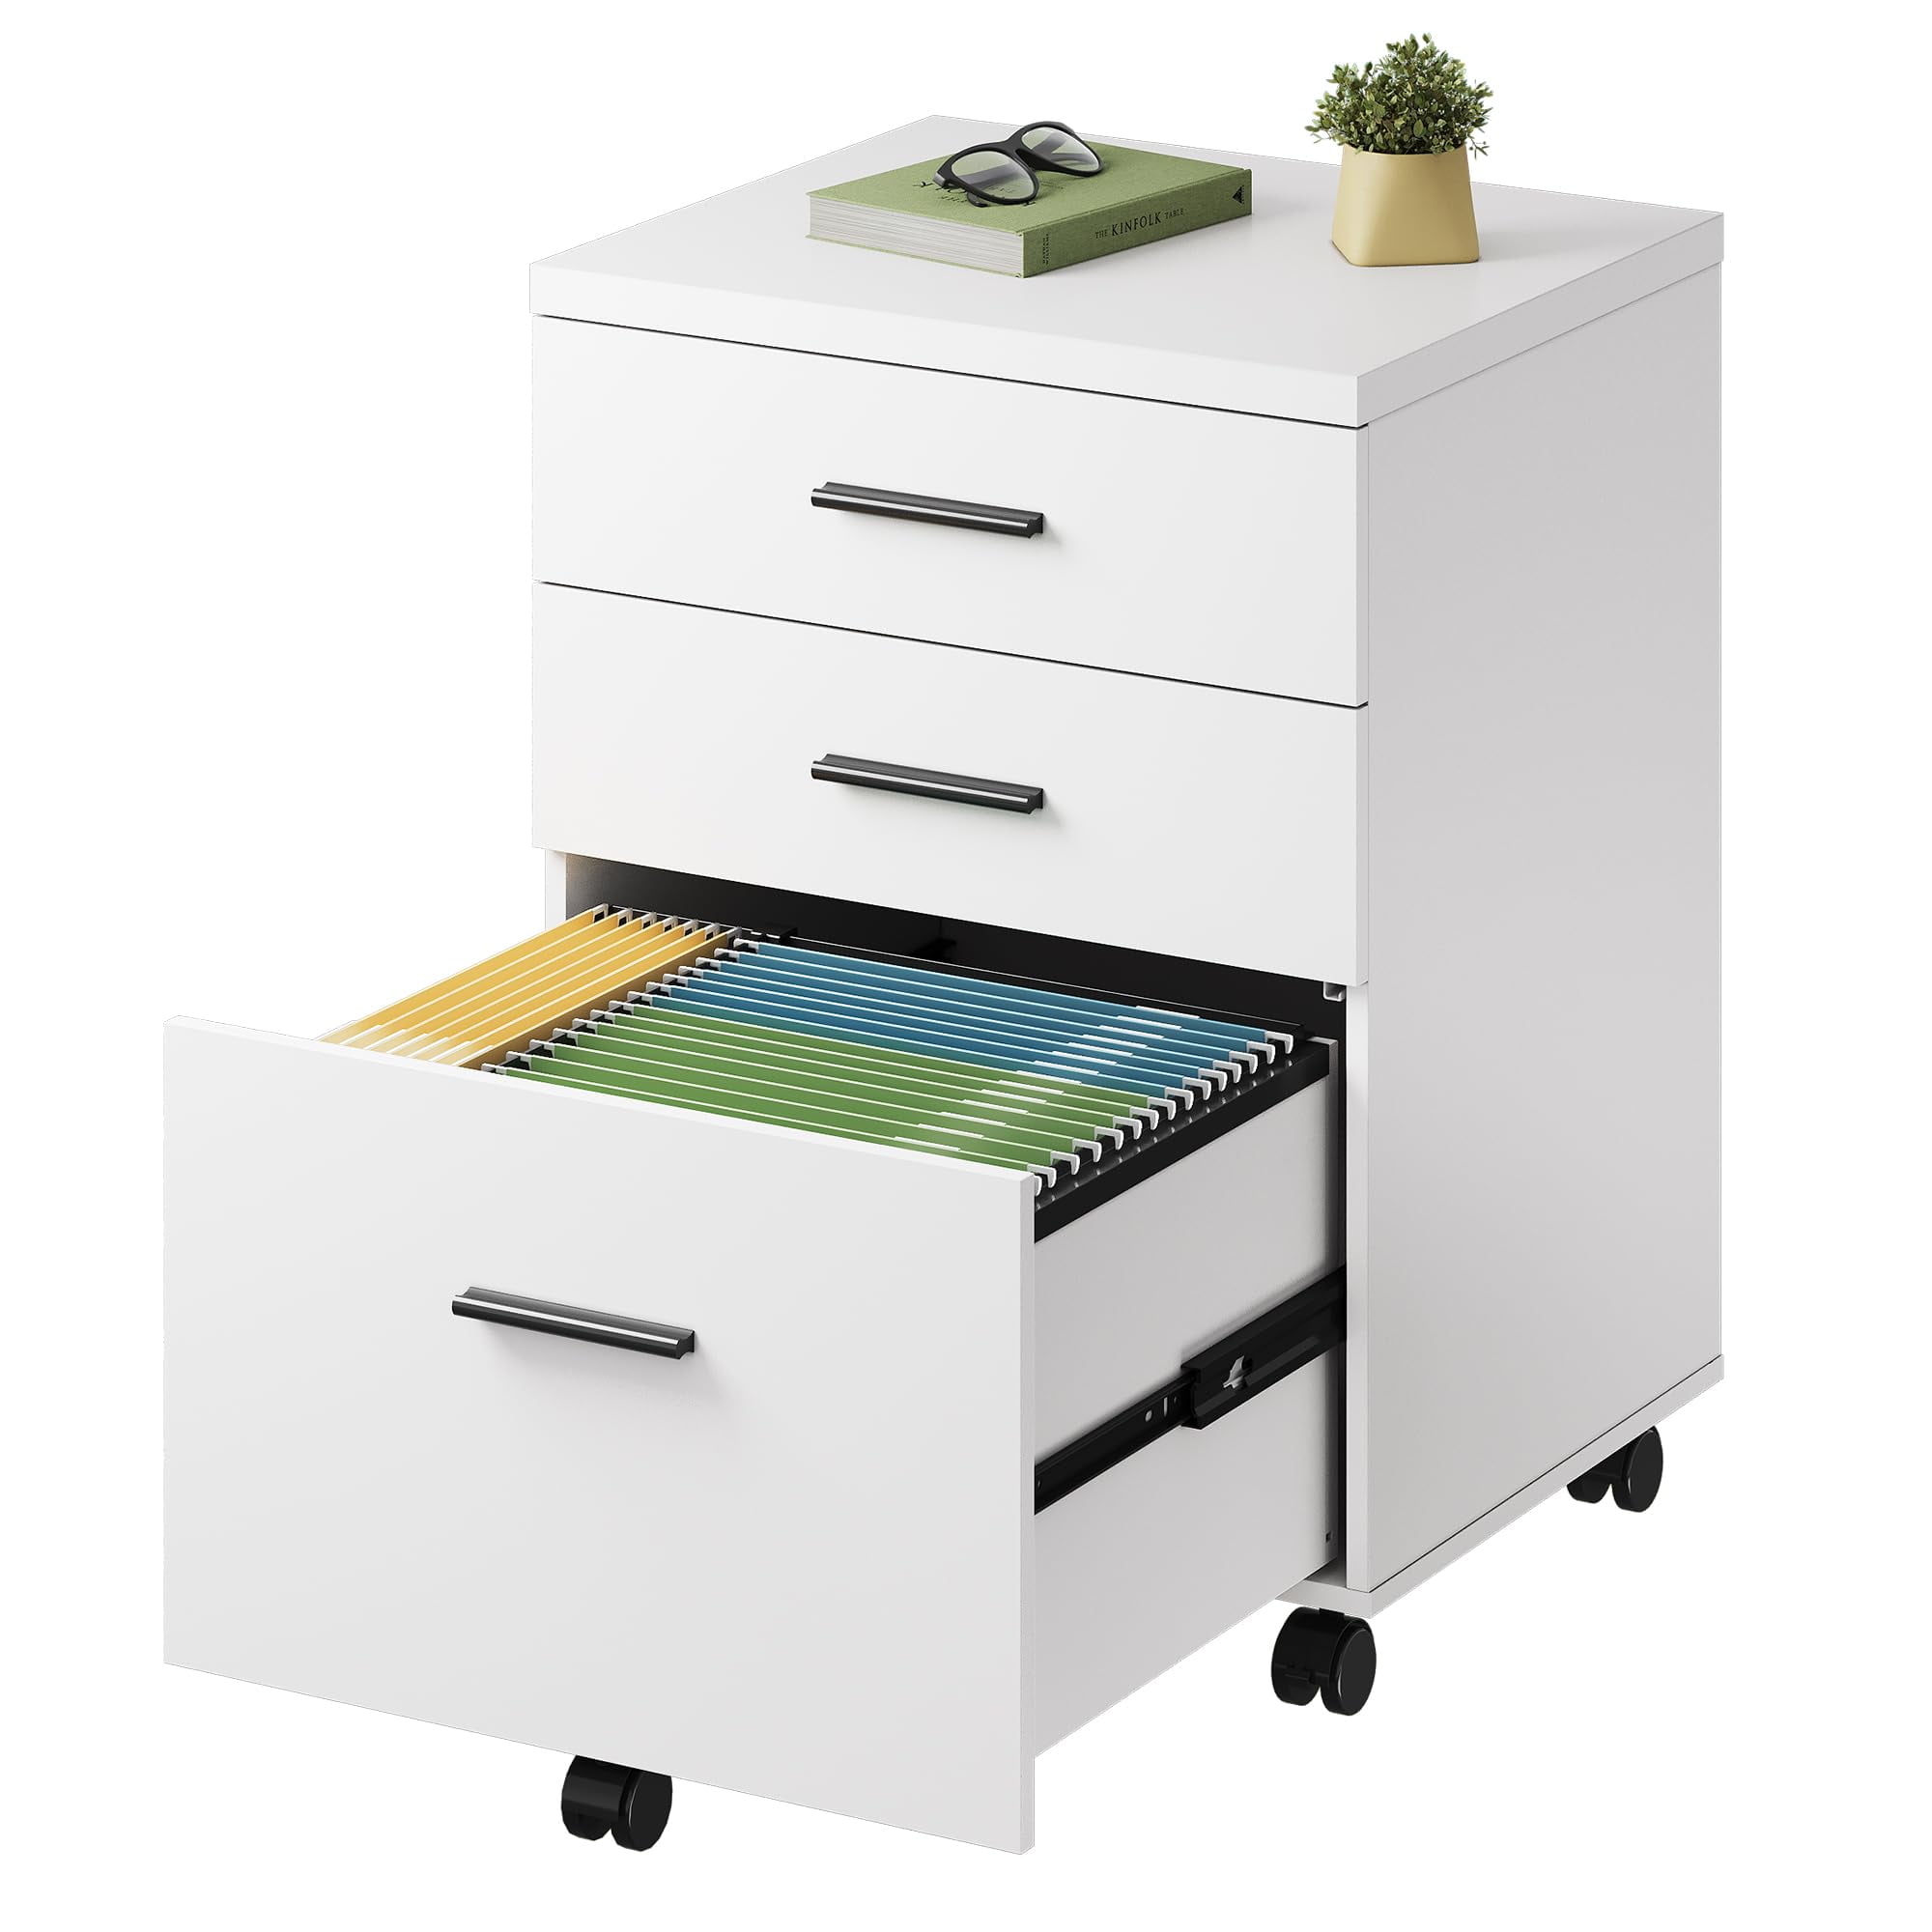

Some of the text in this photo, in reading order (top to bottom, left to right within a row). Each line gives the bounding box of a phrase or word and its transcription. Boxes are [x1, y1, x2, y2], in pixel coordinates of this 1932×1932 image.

[1095, 208, 1183, 240] THE KINFOLK TABLE
